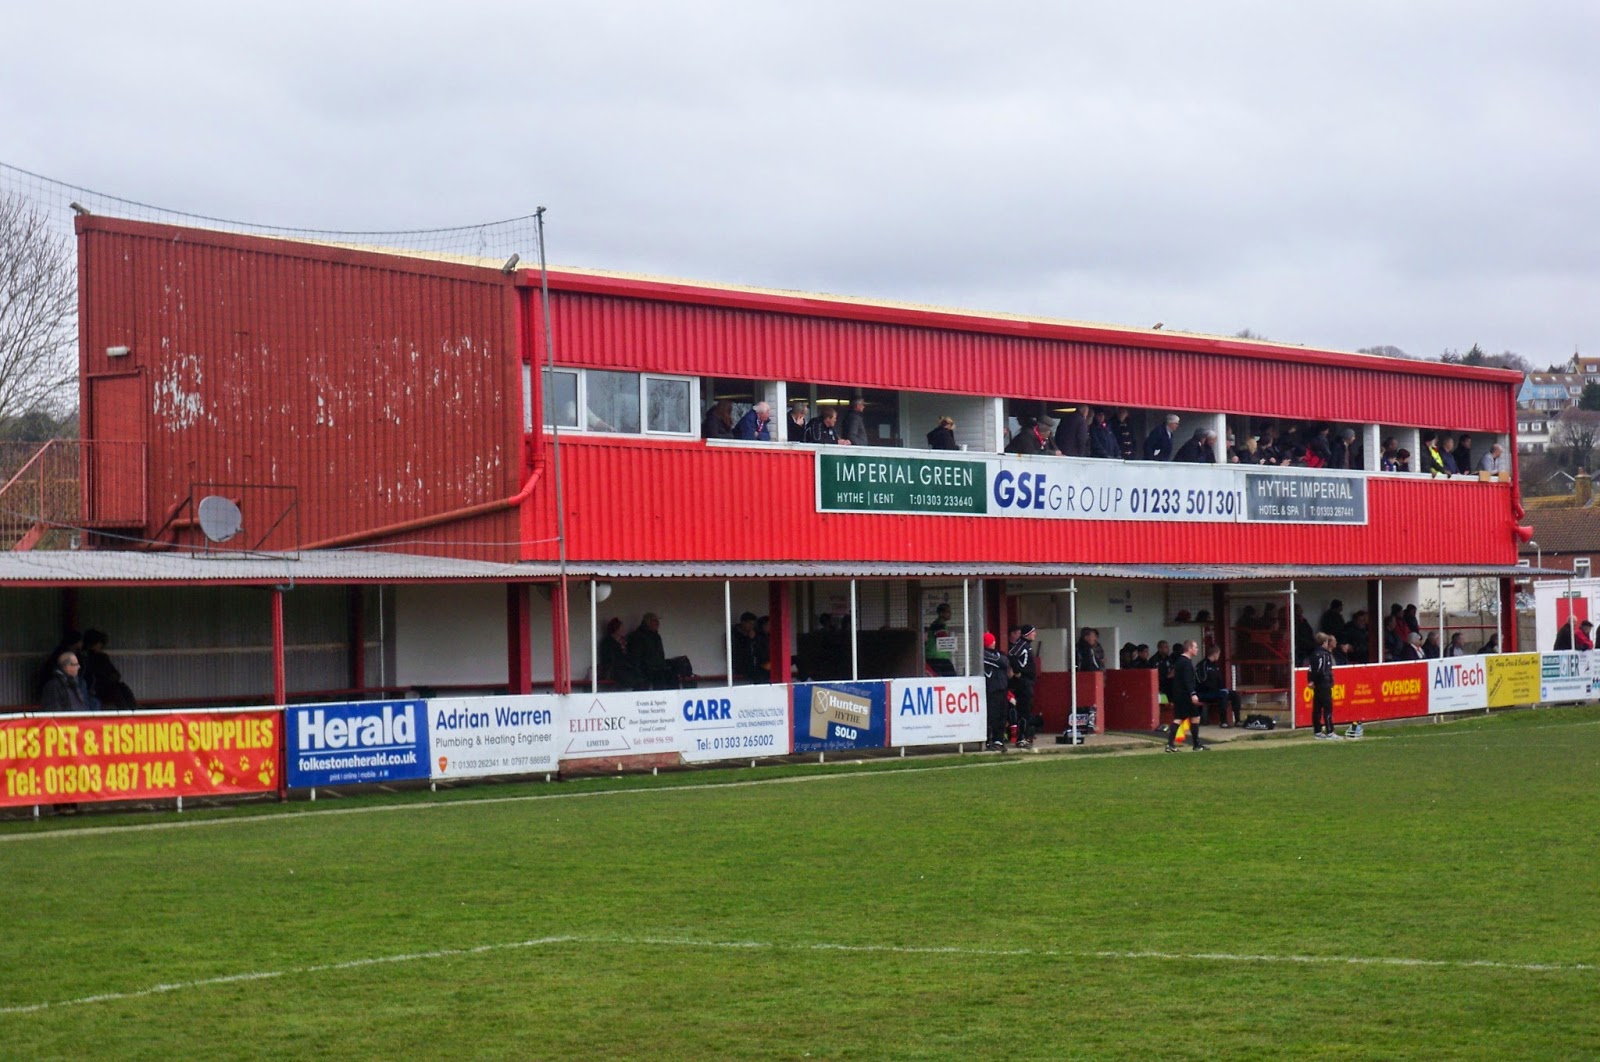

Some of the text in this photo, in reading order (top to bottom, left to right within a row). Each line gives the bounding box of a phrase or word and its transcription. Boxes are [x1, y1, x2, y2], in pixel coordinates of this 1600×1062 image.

[836, 462, 973, 486] IMPERIAL GREEN
[837, 492, 864, 504] HYTHE
[874, 493, 894, 504] KENT
[944, 495, 973, 507] 233640
[1258, 480, 1353, 499] HYTHE IMPERIAL
[1130, 488, 1180, 514] 01233
[1186, 489, 1241, 515] 501301
[1259, 505, 1280, 515] HOTEL
[1281, 505, 1286, 515] &
[1287, 505, 1299, 516] SPA
[1434, 662, 1484, 689] AMTech
[1382, 679, 1420, 696] OVENDEN
[683, 698, 732, 722] CARR
[829, 695, 869, 715] Hunters
[900, 685, 980, 716] AMTech
[436, 707, 551, 730] Adrian Warren
[569, 716, 626, 733] ELITESEC
[834, 710, 860, 723] HYTHE
[298, 705, 416, 750] Herald
[835, 725, 857, 740] SOLD
[44, 725, 79, 758] PET
[84, 729, 99, 756] &
[102, 722, 184, 755] FISHING
[188, 718, 274, 750] SUPPLIES
[436, 733, 552, 748] Plumbing & Heating Engineer
[586, 739, 610, 747] LIMITED
[697, 734, 774, 751] Tel: 01303 265002
[298, 751, 416, 772] folkestoneherald.co.uk
[5, 760, 176, 797] Tel: 01303 487 144
